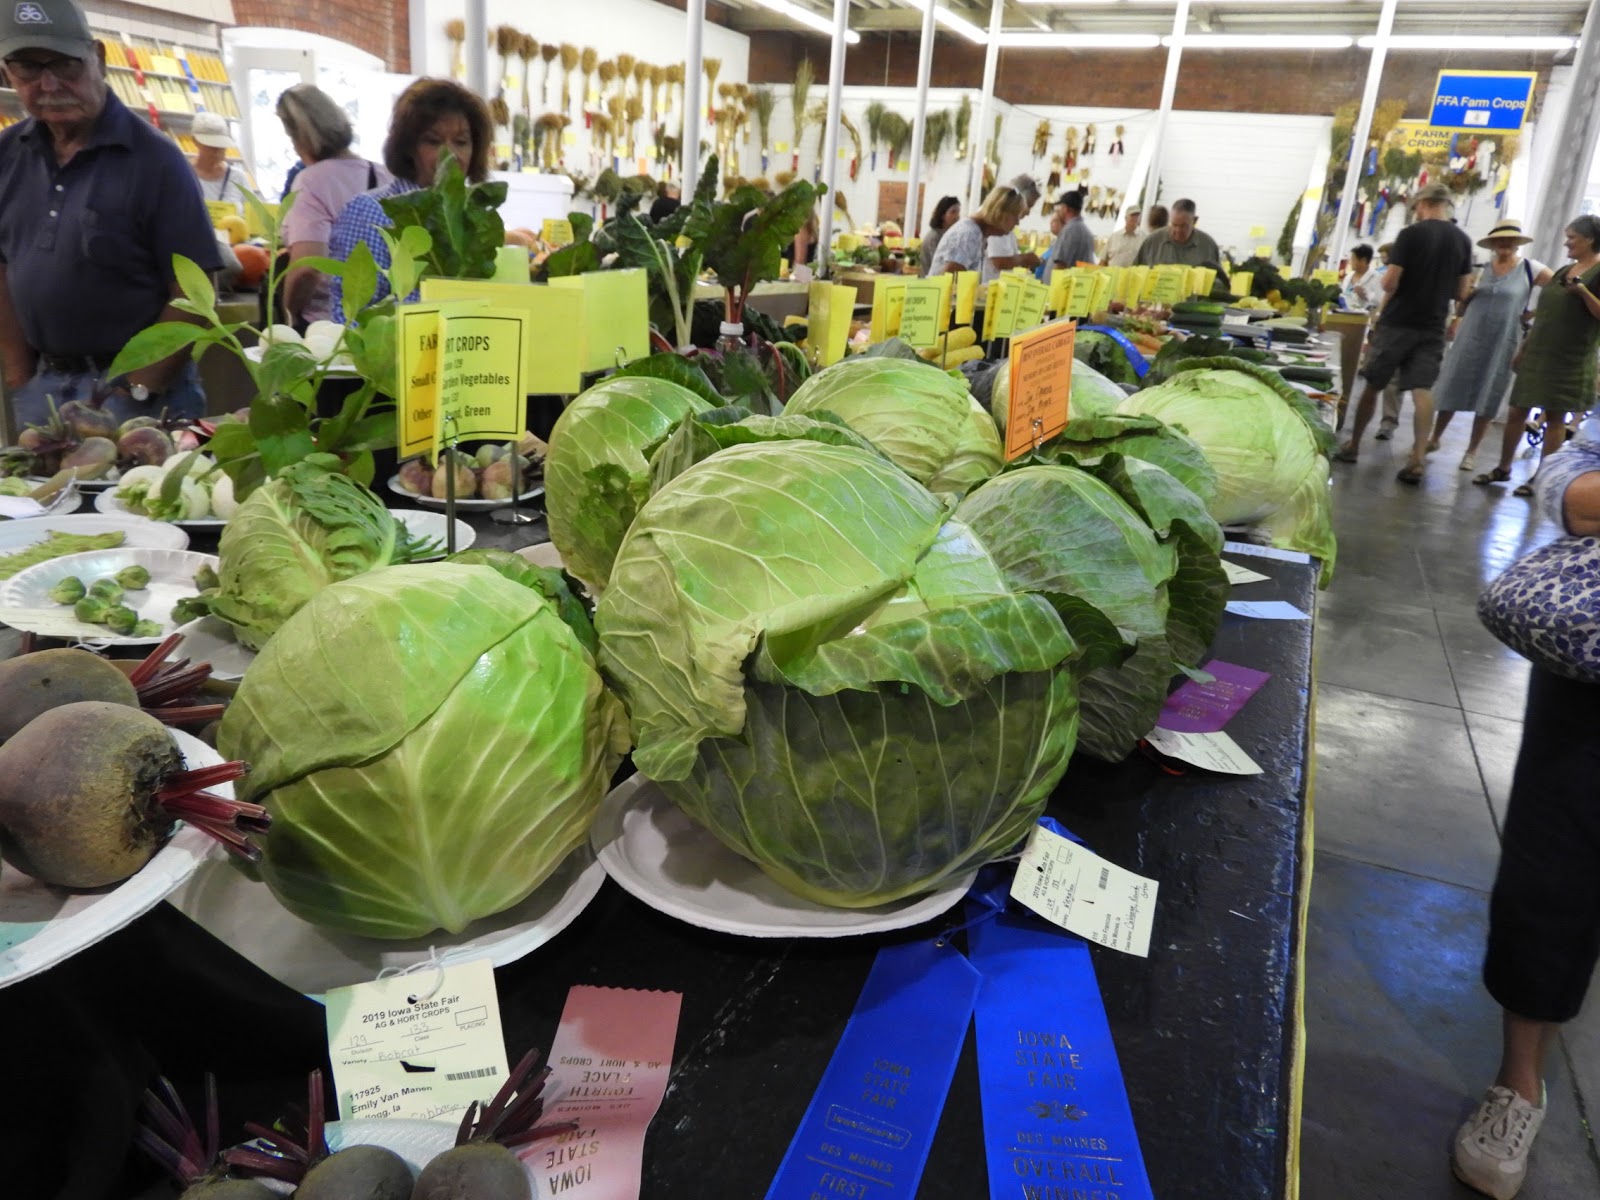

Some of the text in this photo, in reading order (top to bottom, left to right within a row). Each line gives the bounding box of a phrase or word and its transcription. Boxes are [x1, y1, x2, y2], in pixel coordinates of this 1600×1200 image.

[1435, 95, 1526, 110] FFA Farm Crops
[1414, 129, 1450, 138] FARM
[1408, 139, 1451, 149] CROPS
[456, 336, 490, 351] CROPS
[460, 372, 510, 387] Vegetables
[464, 405, 491, 417] Green
[362, 995, 460, 1023] 2019 Iowa State Fair
[374, 1007, 450, 1029] AG & HORT CROPS
[459, 1020, 486, 1031] PLACING
[414, 1034, 430, 1042] Class
[1017, 1030, 1072, 1050] IOWA
[351, 1047, 373, 1055] Division
[341, 1058, 367, 1066] Variety
[560, 1056, 592, 1066] CROPS
[599, 1059, 626, 1067] HORT
[873, 1057, 911, 1078] IOWA
[1015, 1050, 1083, 1070] STATE
[581, 1070, 631, 1083] PLACE
[864, 1071, 911, 1096] STATE
[1028, 1071, 1078, 1090] FAIR
[349, 1085, 381, 1101] 117925
[569, 1086, 634, 1096] FOURTH
[351, 1099, 378, 1114] Emily
[380, 1092, 399, 1103] Van
[557, 1102, 601, 1113] MOINES
[861, 1089, 897, 1110] FAIR
[1017, 1131, 1108, 1151] DES MOINES
[546, 1140, 599, 1169] STATE
[820, 1142, 894, 1173] DES MOINES
[1013, 1156, 1124, 1186] OVERALL
[549, 1163, 592, 1196] IOWA
[818, 1172, 869, 1200] FIRST
